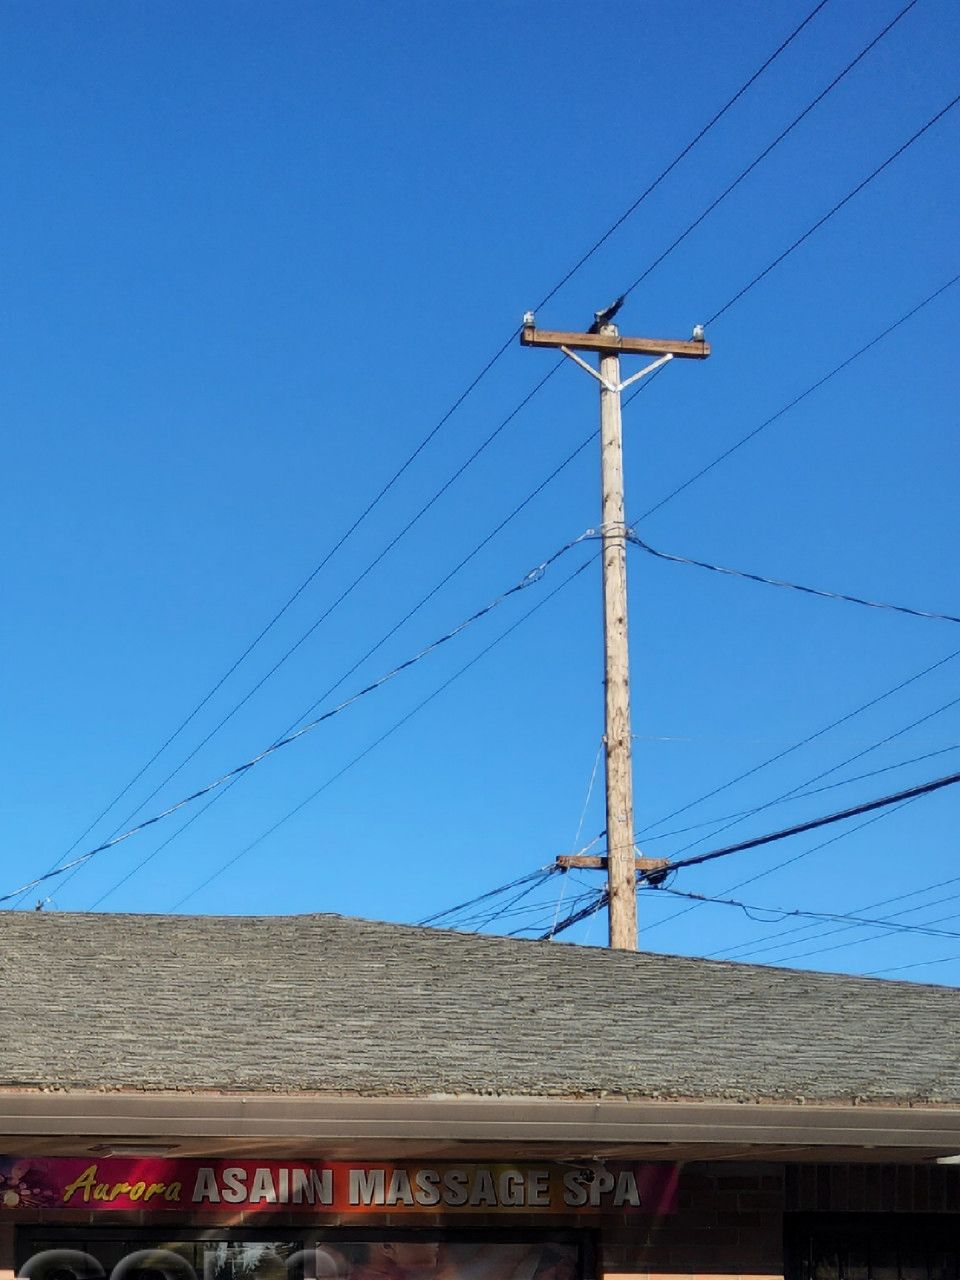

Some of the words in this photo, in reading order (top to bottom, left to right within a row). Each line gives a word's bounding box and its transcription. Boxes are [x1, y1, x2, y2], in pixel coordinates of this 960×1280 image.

[62, 1164, 183, 1203] Aurora
[192, 1167, 333, 1205] ASAIN
[348, 1168, 557, 1206] MASSAGE
[564, 1168, 641, 1207] SPA
